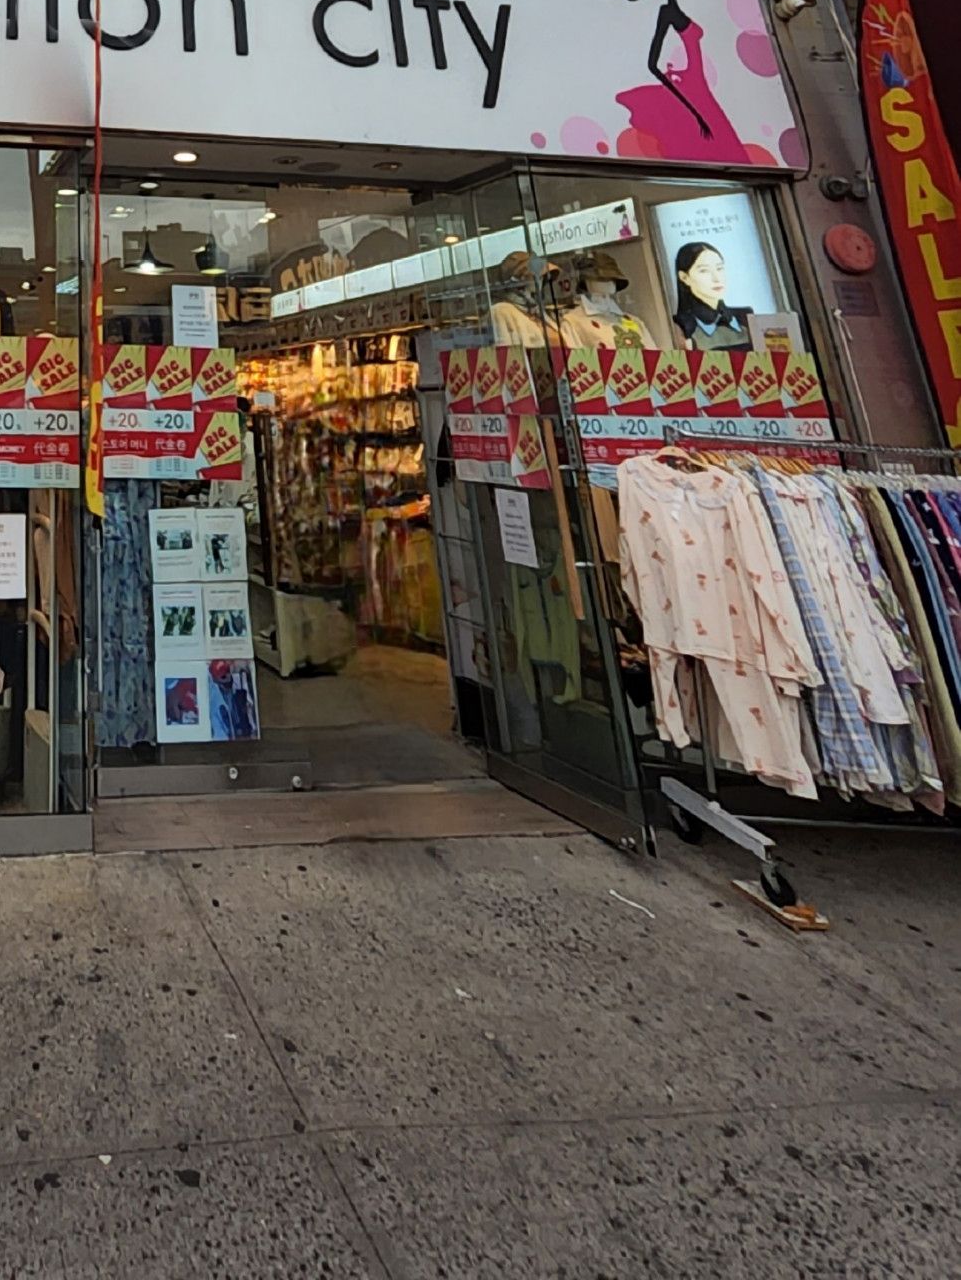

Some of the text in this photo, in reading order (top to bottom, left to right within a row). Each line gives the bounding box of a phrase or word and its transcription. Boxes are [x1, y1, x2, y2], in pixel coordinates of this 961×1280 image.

[535, 217, 609, 246] fashion city
[39, 353, 64, 375] BIG
[40, 361, 77, 391] SALE
[110, 359, 134, 378] BIG
[157, 360, 180, 380] BIG
[201, 362, 224, 381] BIG
[568, 362, 588, 382] BIG
[611, 363, 634, 384] BIG
[655, 363, 678, 384] BIG
[700, 365, 721, 385] BIG
[743, 366, 764, 386] BIG
[785, 366, 805, 386] BIG
[113, 367, 145, 392] SALE
[159, 369, 191, 393] SALE
[204, 370, 237, 395] SALE
[570, 371, 601, 396] SALE
[616, 371, 646, 399] SALE
[661, 371, 690, 399] SALE
[706, 373, 735, 400] SALE
[748, 373, 776, 400] SALE
[791, 374, 818, 401] SALE
[204, 426, 228, 447] BIG
[208, 434, 239, 461] SALE
